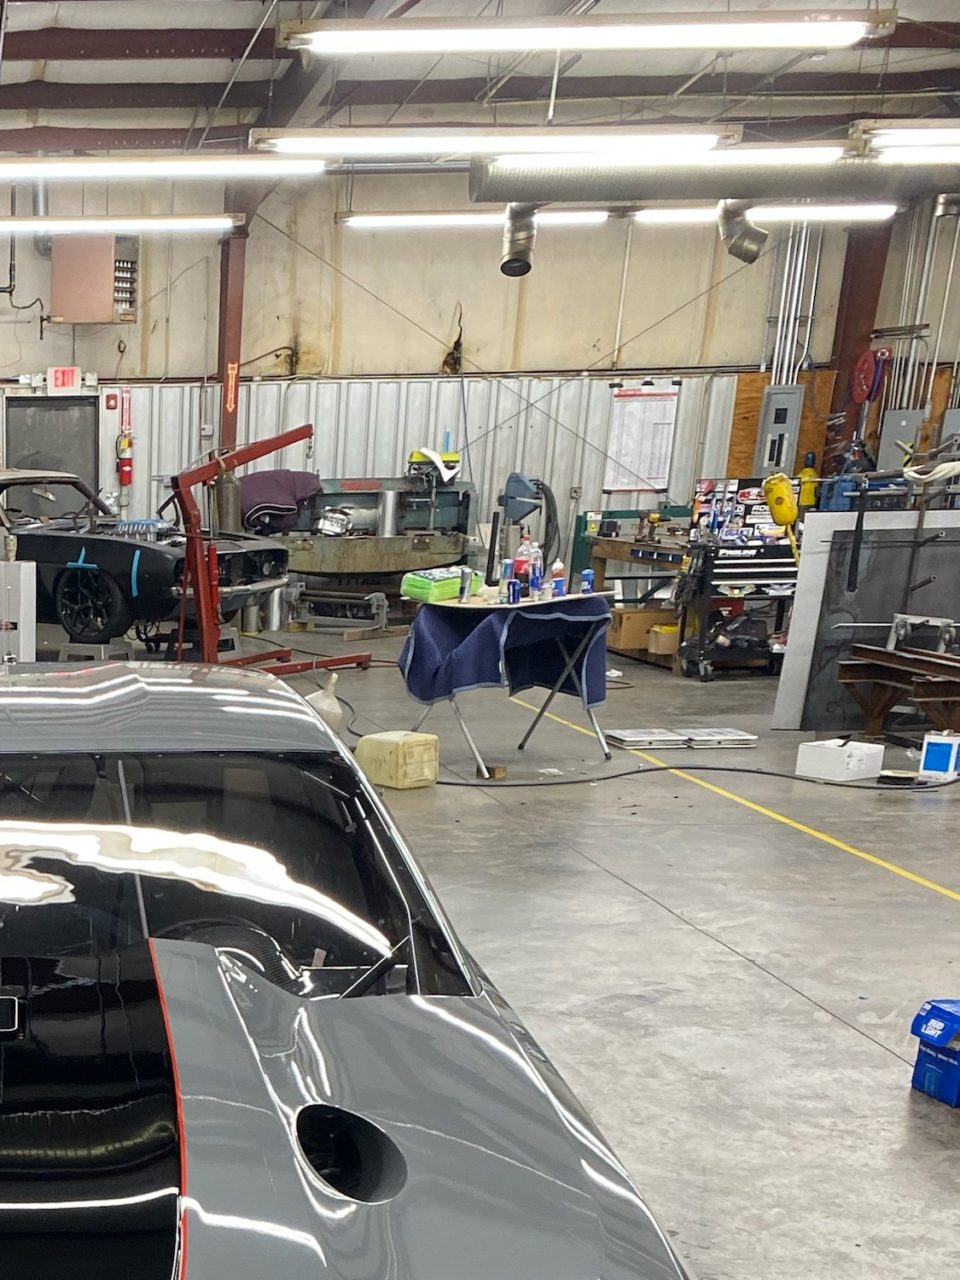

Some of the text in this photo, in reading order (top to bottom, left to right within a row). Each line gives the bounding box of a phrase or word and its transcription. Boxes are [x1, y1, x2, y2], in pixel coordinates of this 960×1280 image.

[54, 368, 75, 388] EXIT
[920, 1023, 943, 1039] LIGHT
[927, 1018, 945, 1031] BUD
